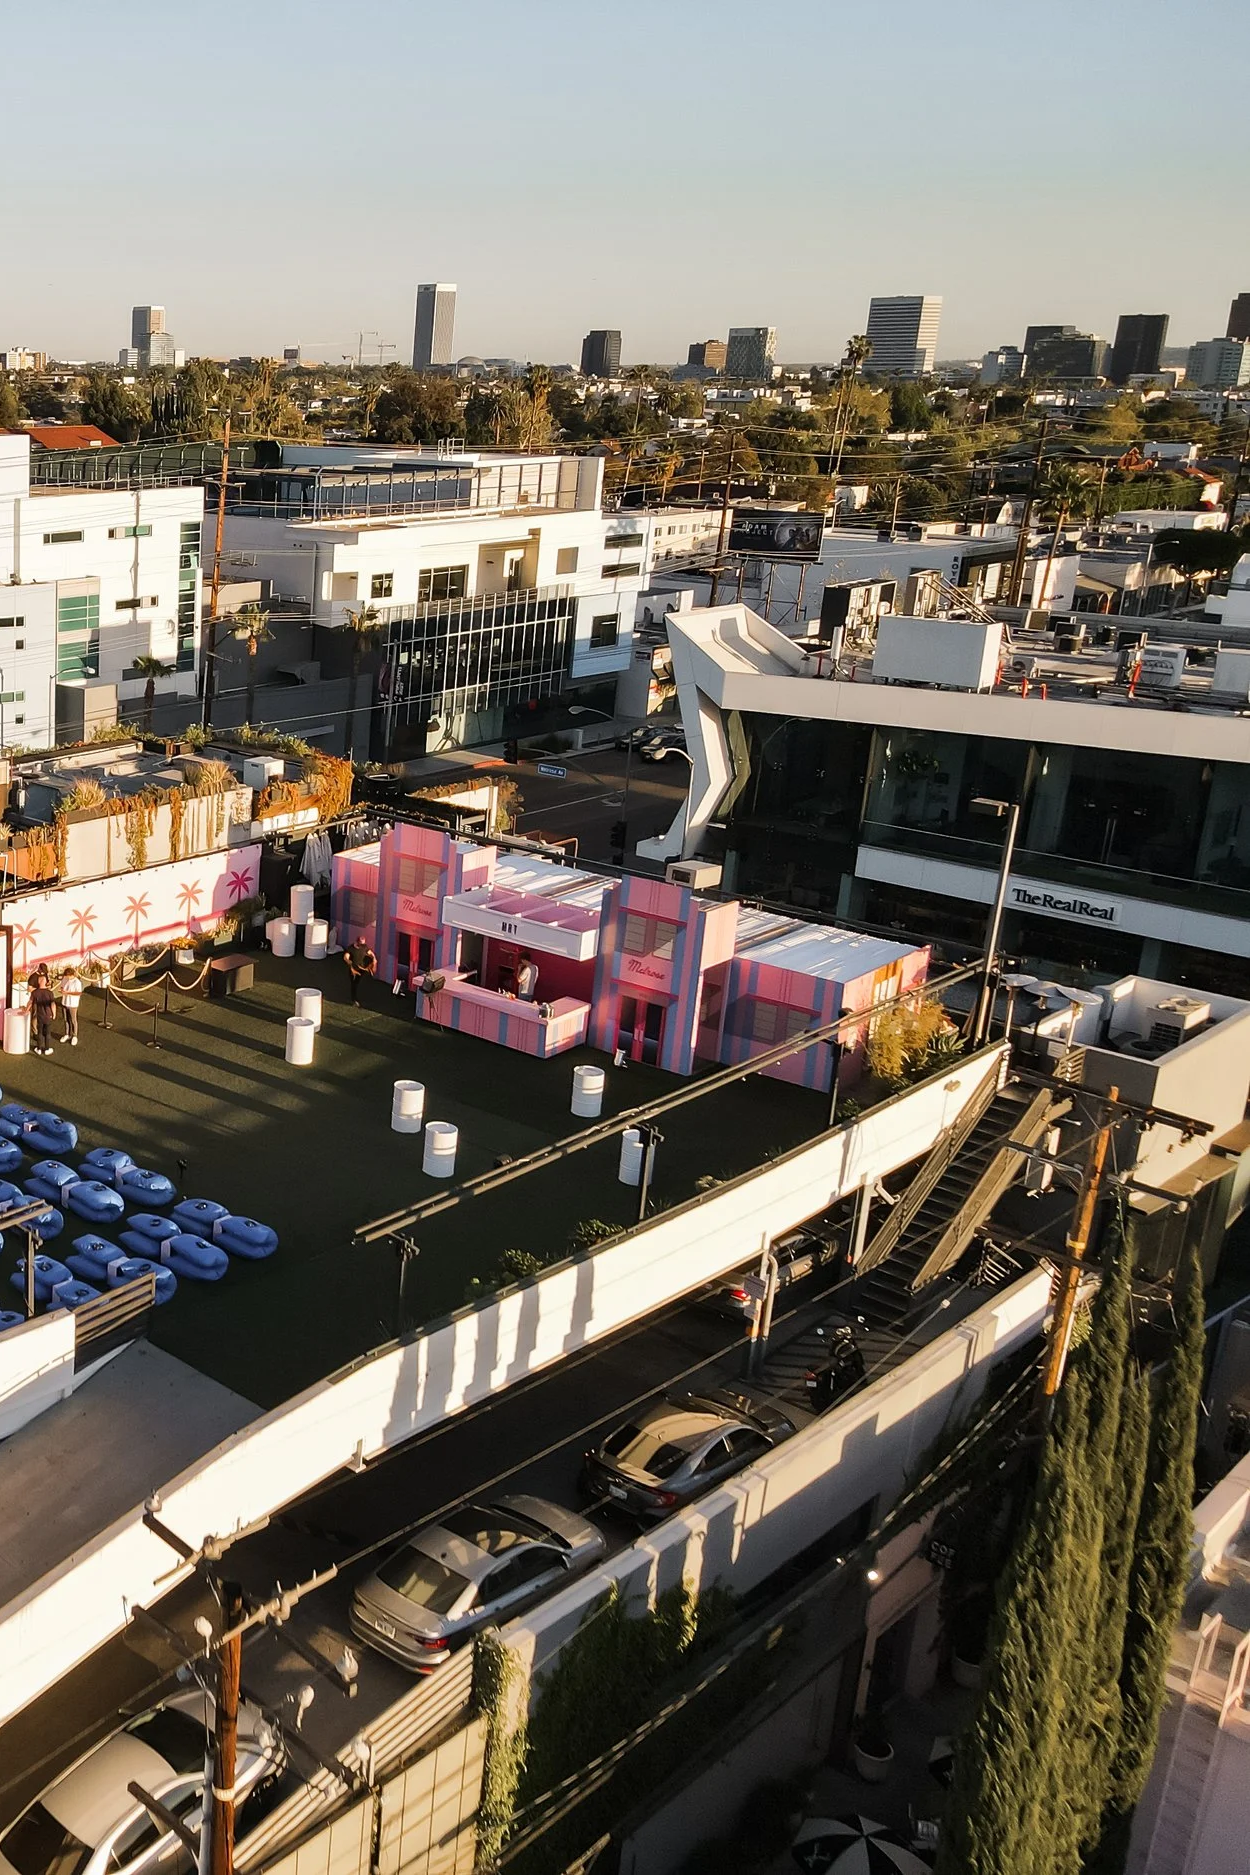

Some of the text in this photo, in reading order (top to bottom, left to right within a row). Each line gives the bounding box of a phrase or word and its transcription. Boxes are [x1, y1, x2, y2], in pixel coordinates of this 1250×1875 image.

[403, 899, 432, 916] Melrose
[1012, 888, 1115, 921] TheRealReal
[628, 959, 666, 980] Melrose
